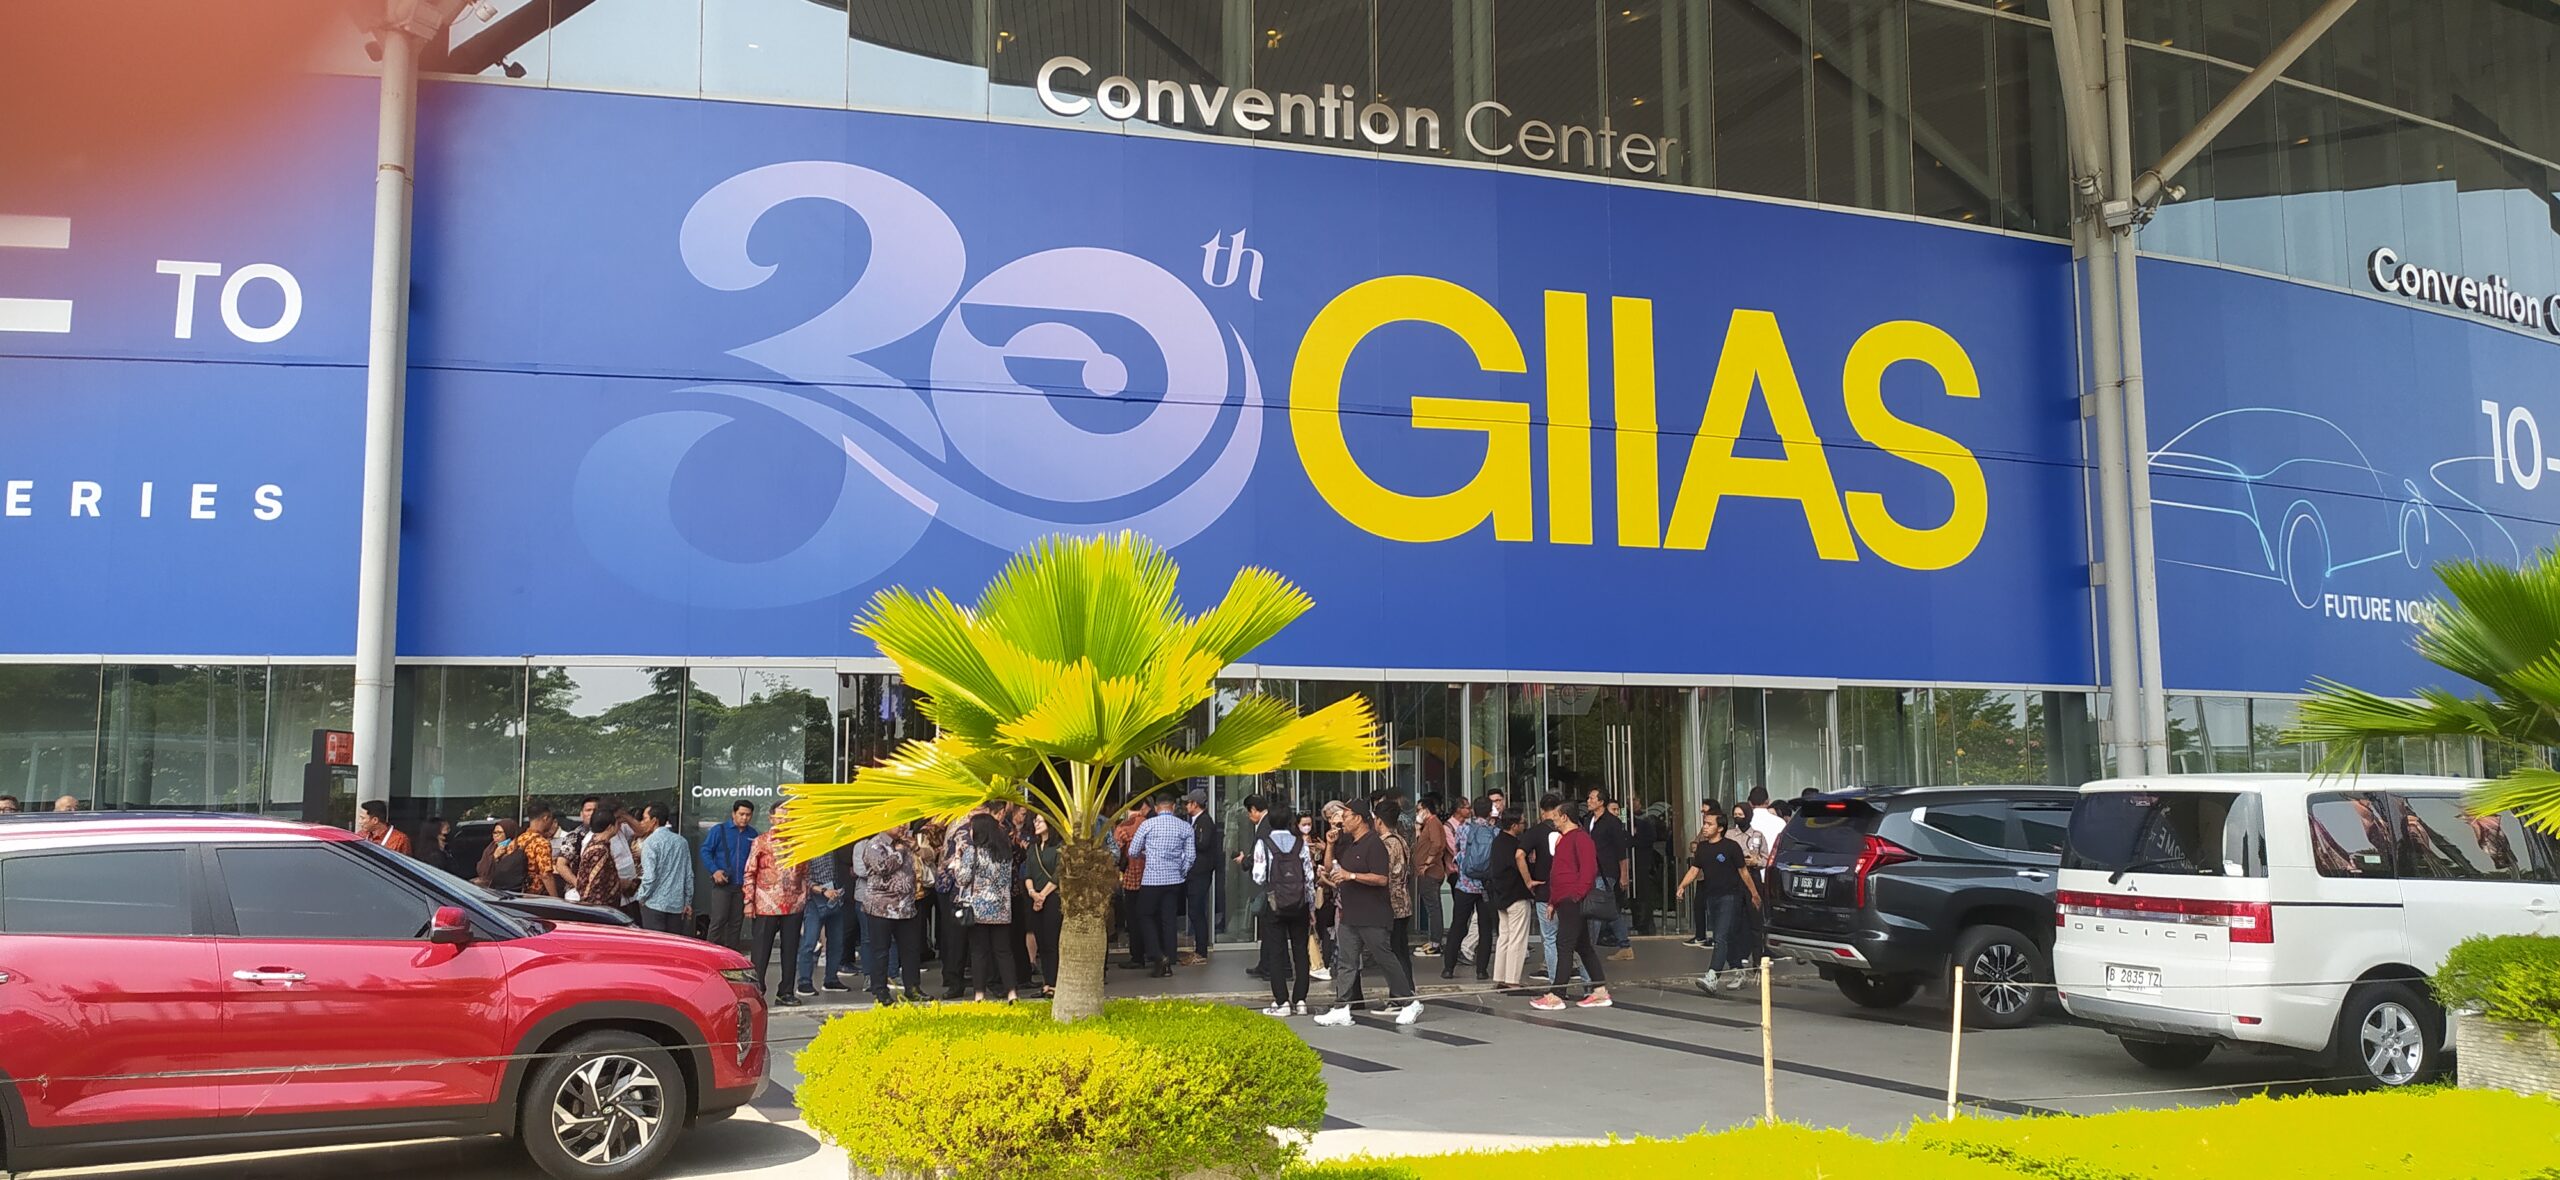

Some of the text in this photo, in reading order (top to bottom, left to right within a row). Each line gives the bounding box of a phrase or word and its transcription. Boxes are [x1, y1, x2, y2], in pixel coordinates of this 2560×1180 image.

[1036, 55, 1678, 177] Convention Center
[156, 260, 302, 343] TO
[2369, 247, 2541, 328] Convention
[1289, 275, 1988, 569] GIIAS
[2324, 593, 2392, 622] FUTURE
[691, 785, 772, 798] Convention
[2075, 922, 2208, 941] DELICA
[2110, 968, 2116, 982] B
[2121, 969, 2145, 985] 2835
